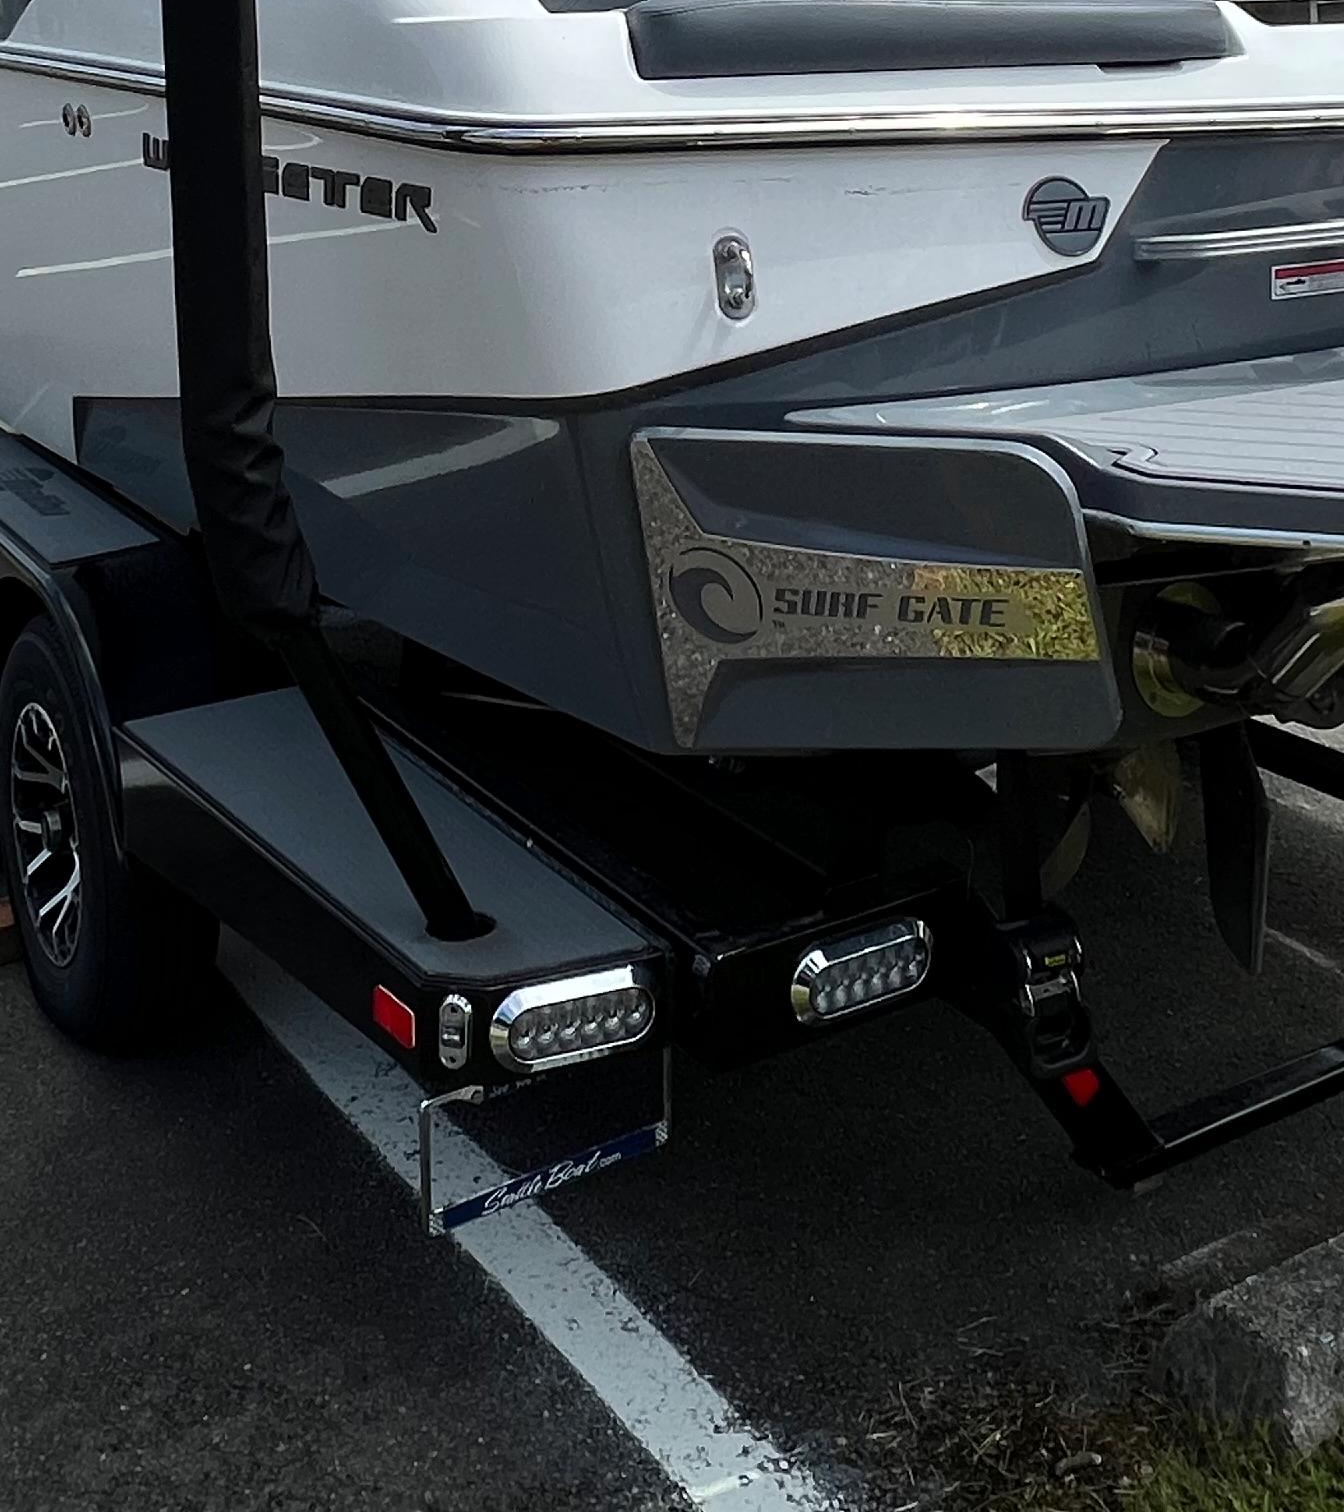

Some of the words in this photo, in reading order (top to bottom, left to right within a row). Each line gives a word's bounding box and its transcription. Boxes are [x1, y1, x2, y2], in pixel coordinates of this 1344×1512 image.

[142, 132, 438, 234] WSETTER
[772, 587, 884, 620] SURF
[896, 594, 1011, 628] GATE
[481, 1174, 542, 1216] Seattle
